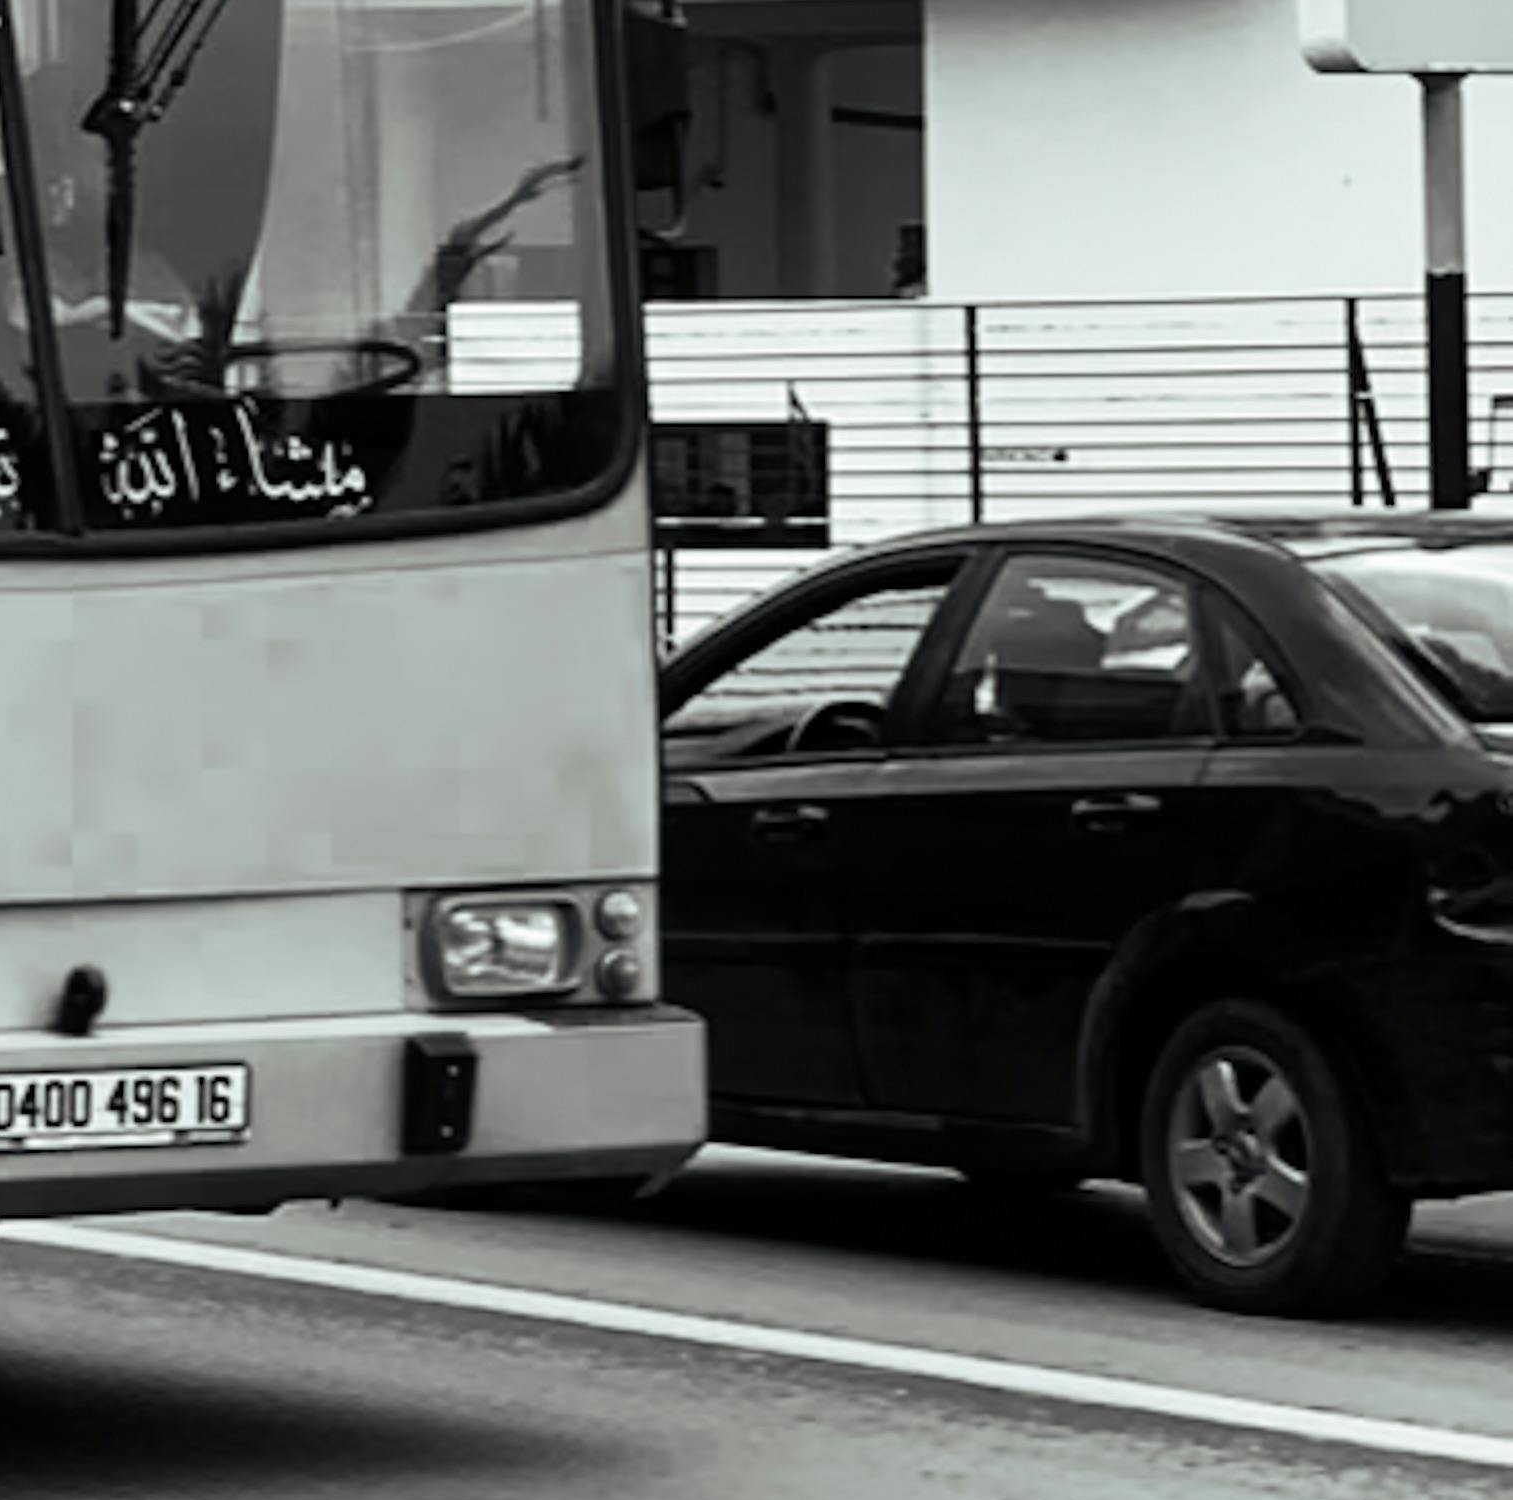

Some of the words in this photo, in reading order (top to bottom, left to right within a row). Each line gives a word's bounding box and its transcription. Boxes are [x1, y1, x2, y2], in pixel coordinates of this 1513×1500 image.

[98, 405, 200, 520] الله
[105, 1079, 180, 1126] 496
[196, 1075, 232, 1122] 16
